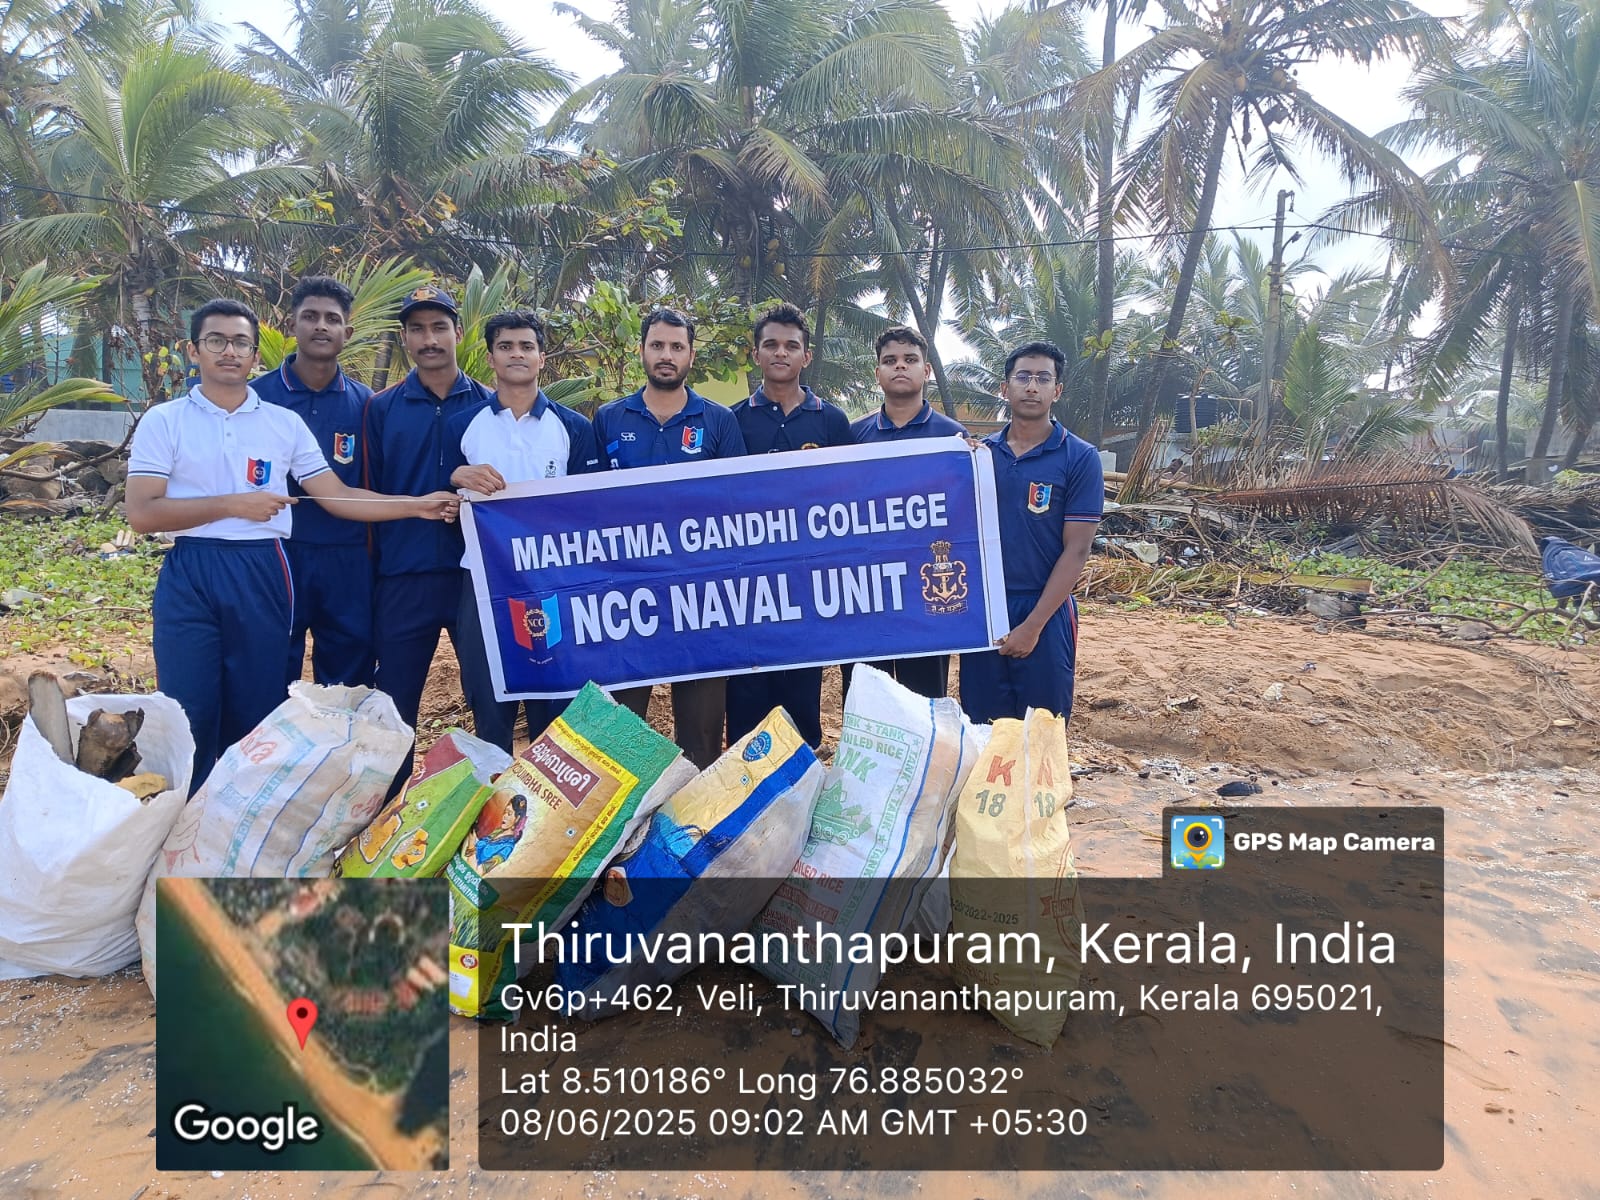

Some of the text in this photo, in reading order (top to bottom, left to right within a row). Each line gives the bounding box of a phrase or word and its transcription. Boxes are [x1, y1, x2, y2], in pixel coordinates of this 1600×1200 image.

[511, 492, 948, 572] MAHATMA GANDHI COLLEGE
[570, 561, 907, 645] NCC NAVAL UNIT
[527, 618, 545, 628] NCC
[843, 732, 904, 760] OILED RICE
[875, 724, 907, 742] TANK
[900, 750, 919, 783] TANK
[986, 755, 1016, 787] K
[540, 788, 563, 811] SREE
[881, 797, 899, 832] TANK
[975, 789, 1007, 818] 18
[1033, 791, 1056, 818] 18
[791, 859, 818, 881] OILED
[815, 872, 844, 894] RICE
[863, 848, 885, 878] TANK
